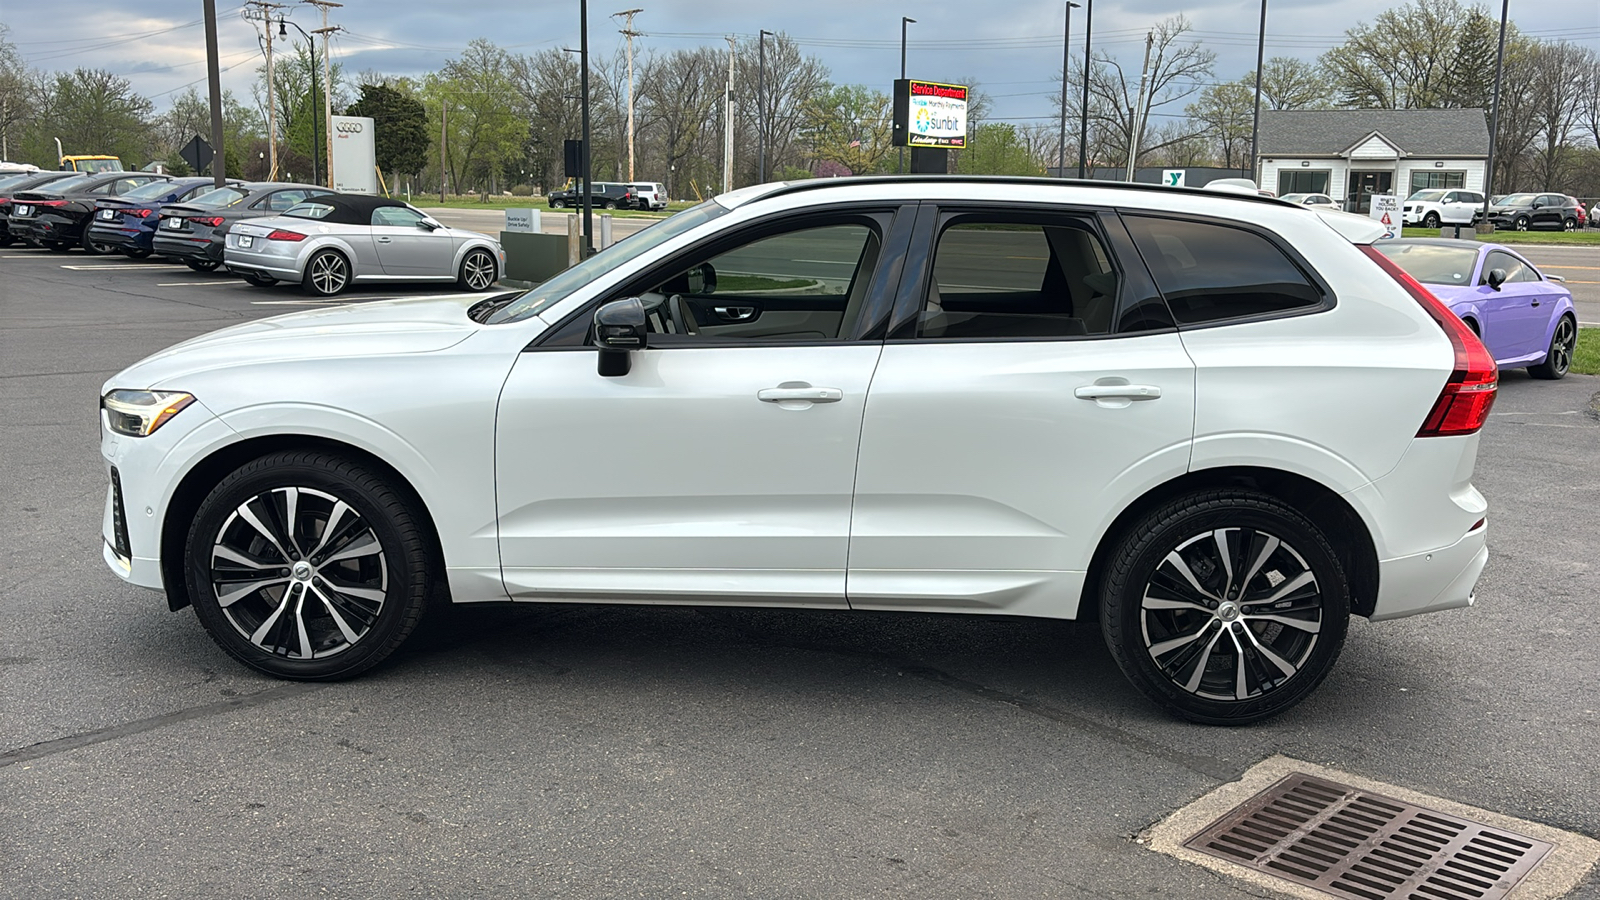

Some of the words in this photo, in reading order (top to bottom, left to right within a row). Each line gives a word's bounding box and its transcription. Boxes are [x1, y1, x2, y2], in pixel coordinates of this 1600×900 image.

[912, 83, 933, 95] Service
[933, 85, 965, 98] Department
[929, 100, 945, 109] Monthly
[946, 101, 964, 110] Payments
[931, 116, 958, 131] sunbit
